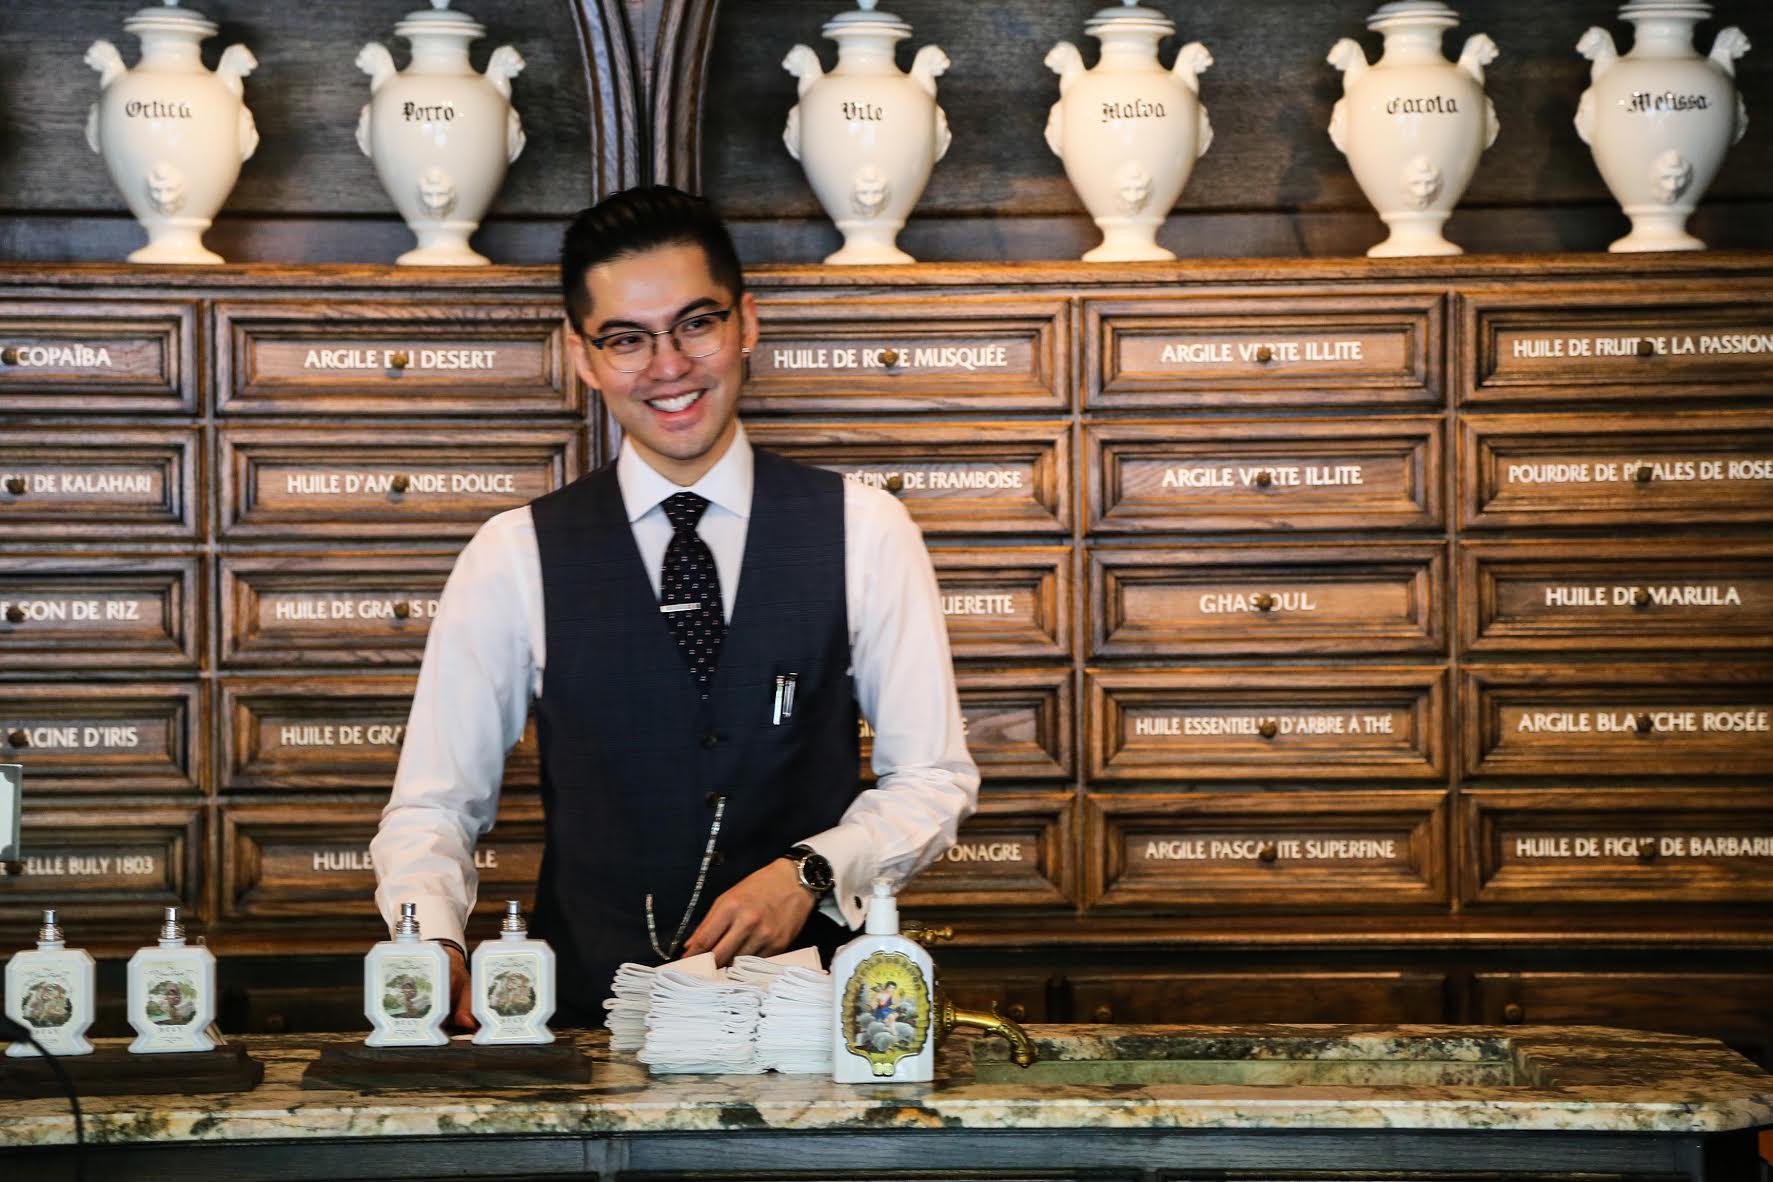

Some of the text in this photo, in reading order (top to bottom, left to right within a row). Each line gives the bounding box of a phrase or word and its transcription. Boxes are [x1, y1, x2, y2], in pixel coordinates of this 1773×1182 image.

[403, 101, 454, 121] Porro
[1160, 344, 1232, 362] ARGILE
[1305, 341, 1363, 360] ILLITE
[1513, 339, 1563, 357] HUILE
[1568, 339, 1591, 356] DE
[1671, 336, 1696, 354] LA
[304, 350, 378, 369] ARGILE
[420, 350, 497, 369] DESERT
[773, 350, 829, 369] HUILE
[834, 350, 858, 369] DE
[914, 345, 1007, 370] MUSQUÉE
[903, 472, 926, 489] DE
[929, 471, 1022, 489] FRAMBOISE
[1160, 468, 1232, 487] ARGILE
[1305, 465, 1363, 485] ILLITE
[1594, 463, 1617, 481] DE
[1700, 462, 1725, 480] DE
[34, 474, 56, 492] DE
[61, 474, 152, 493] KALAHARI
[287, 473, 515, 493] HUILE D'AMNDE DOUCE
[1199, 592, 1317, 613] GHASOUL
[1545, 586, 1608, 606] HUILE
[18, 600, 65, 620] SON
[72, 600, 99, 621] DE
[106, 601, 139, 621] RIZ
[275, 602, 326, 619] HUILE
[331, 601, 354, 619] DE
[358, 600, 423, 618] GRAS
[1135, 716, 1180, 736] HUILE
[1279, 716, 1344, 735] D'ARBRE
[1363, 713, 1393, 734] THÉ
[1517, 708, 1771, 732] ARGILE BLACHE ROSÉE
[84, 727, 139, 747] D'IRIS
[281, 727, 334, 745] HUILE
[339, 726, 363, 745] DE
[1145, 839, 1396, 860] ARGILE PASCITE SUPERFINE
[1516, 838, 1571, 857] HUILE
[1574, 838, 1600, 857] DE
[1660, 837, 1686, 857] DE
[68, 857, 110, 875] BULY
[115, 856, 153, 875] 1803
[312, 852, 374, 870] HUILE
